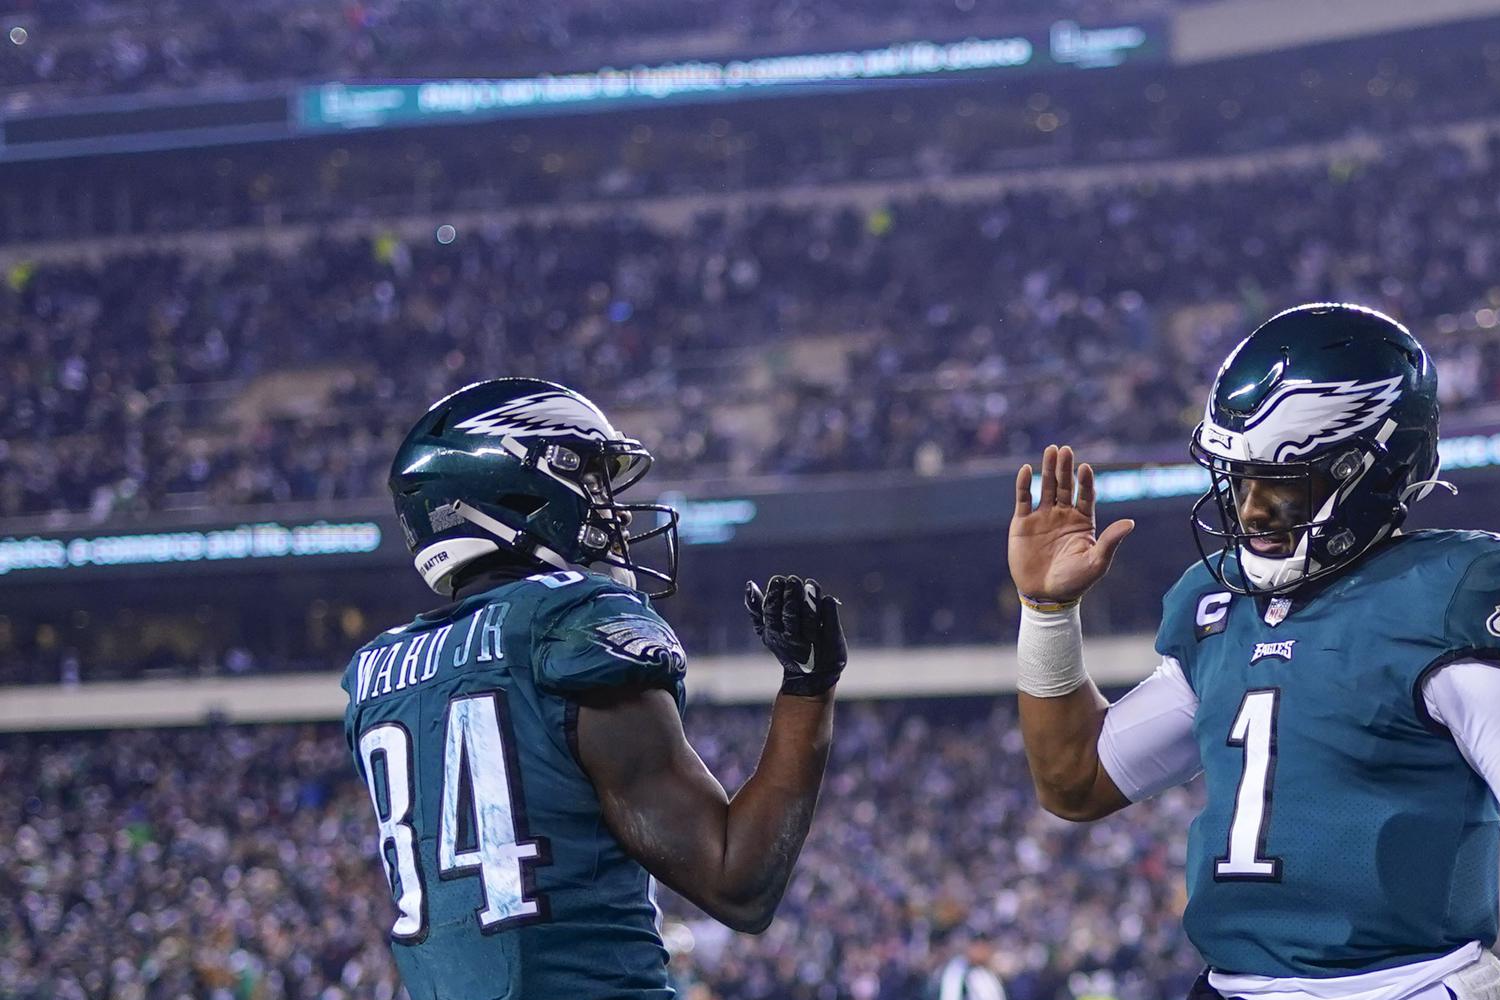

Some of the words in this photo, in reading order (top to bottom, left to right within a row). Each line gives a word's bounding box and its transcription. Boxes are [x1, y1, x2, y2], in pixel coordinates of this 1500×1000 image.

[423, 551, 449, 572] MATTER
[1196, 592, 1232, 626] C
[356, 626, 444, 704] WARD
[453, 602, 511, 668] JR
[1250, 640, 1296, 662] EAGLES
[357, 690, 550, 944] 84
[1214, 688, 1282, 882] 1
